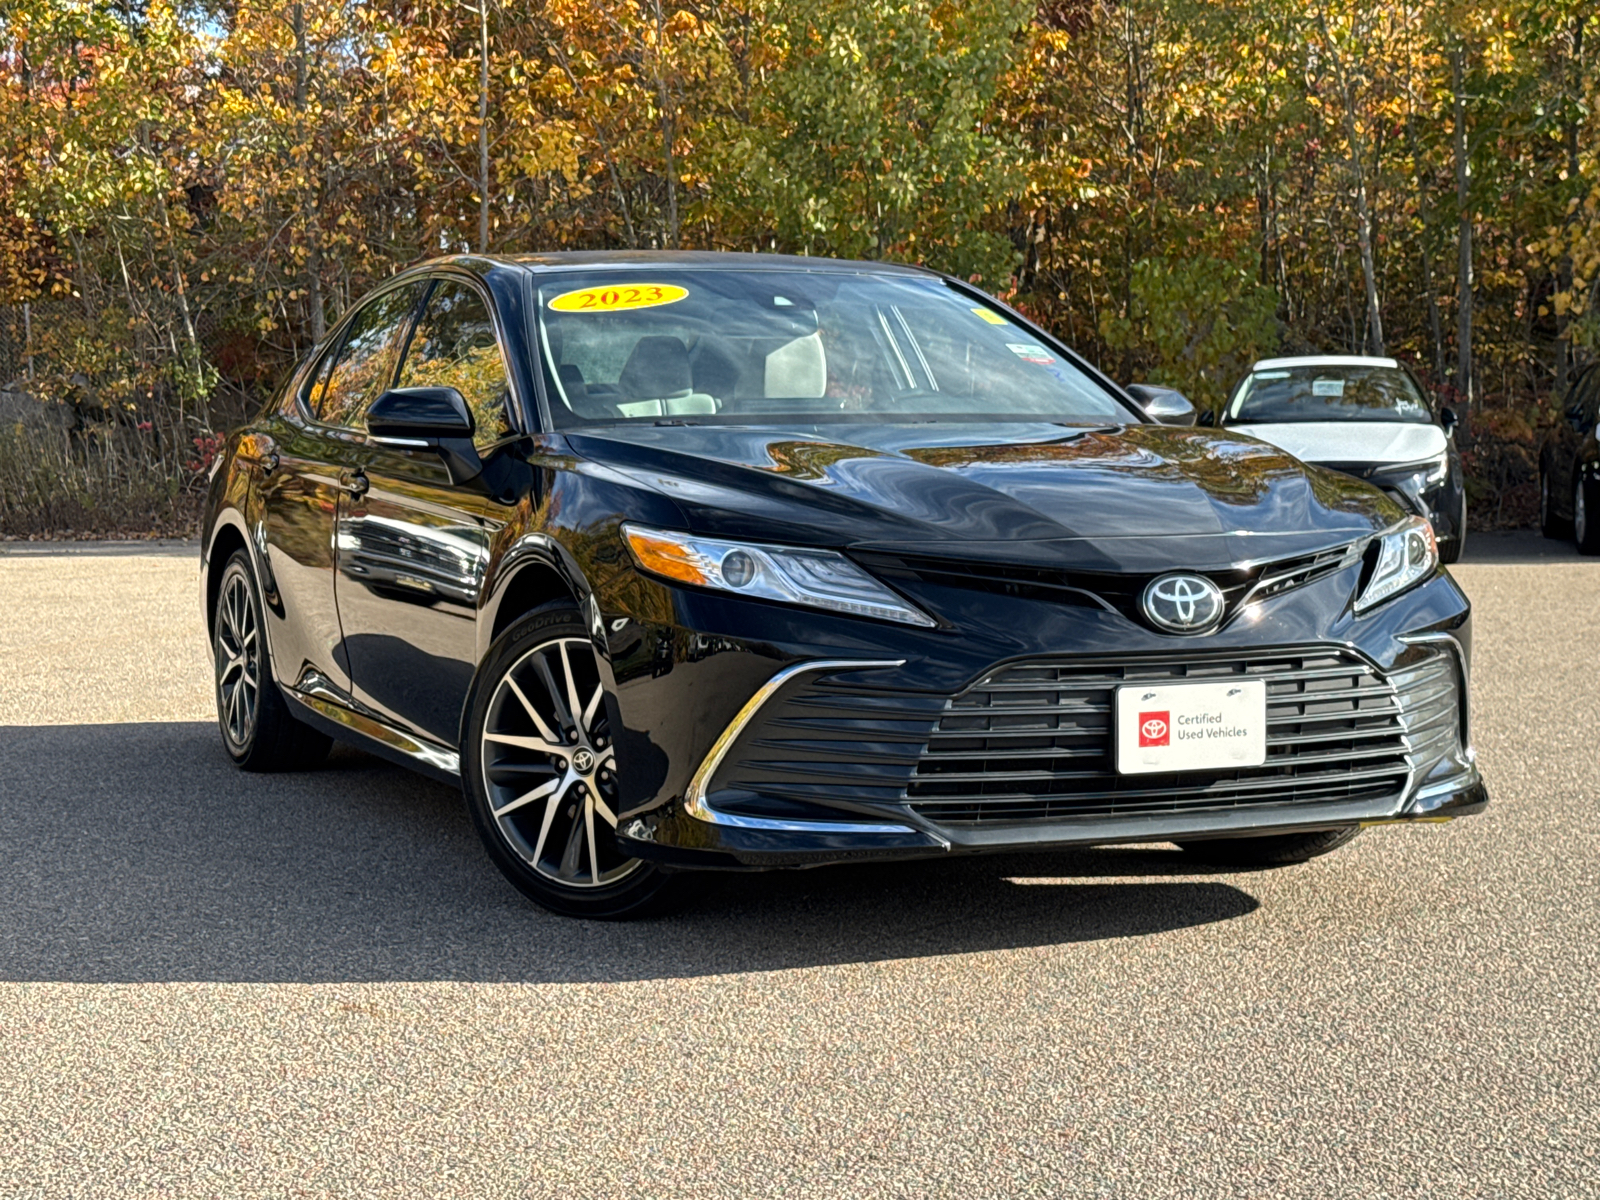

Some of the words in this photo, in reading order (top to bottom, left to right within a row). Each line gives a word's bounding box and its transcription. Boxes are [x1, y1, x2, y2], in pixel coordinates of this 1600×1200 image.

[579, 287, 663, 309] 2023
[512, 613, 572, 642] GeoDrive
[1177, 712, 1222, 725] Certified
[1178, 728, 1204, 740] Used
[1206, 726, 1247, 739] Vehicles
